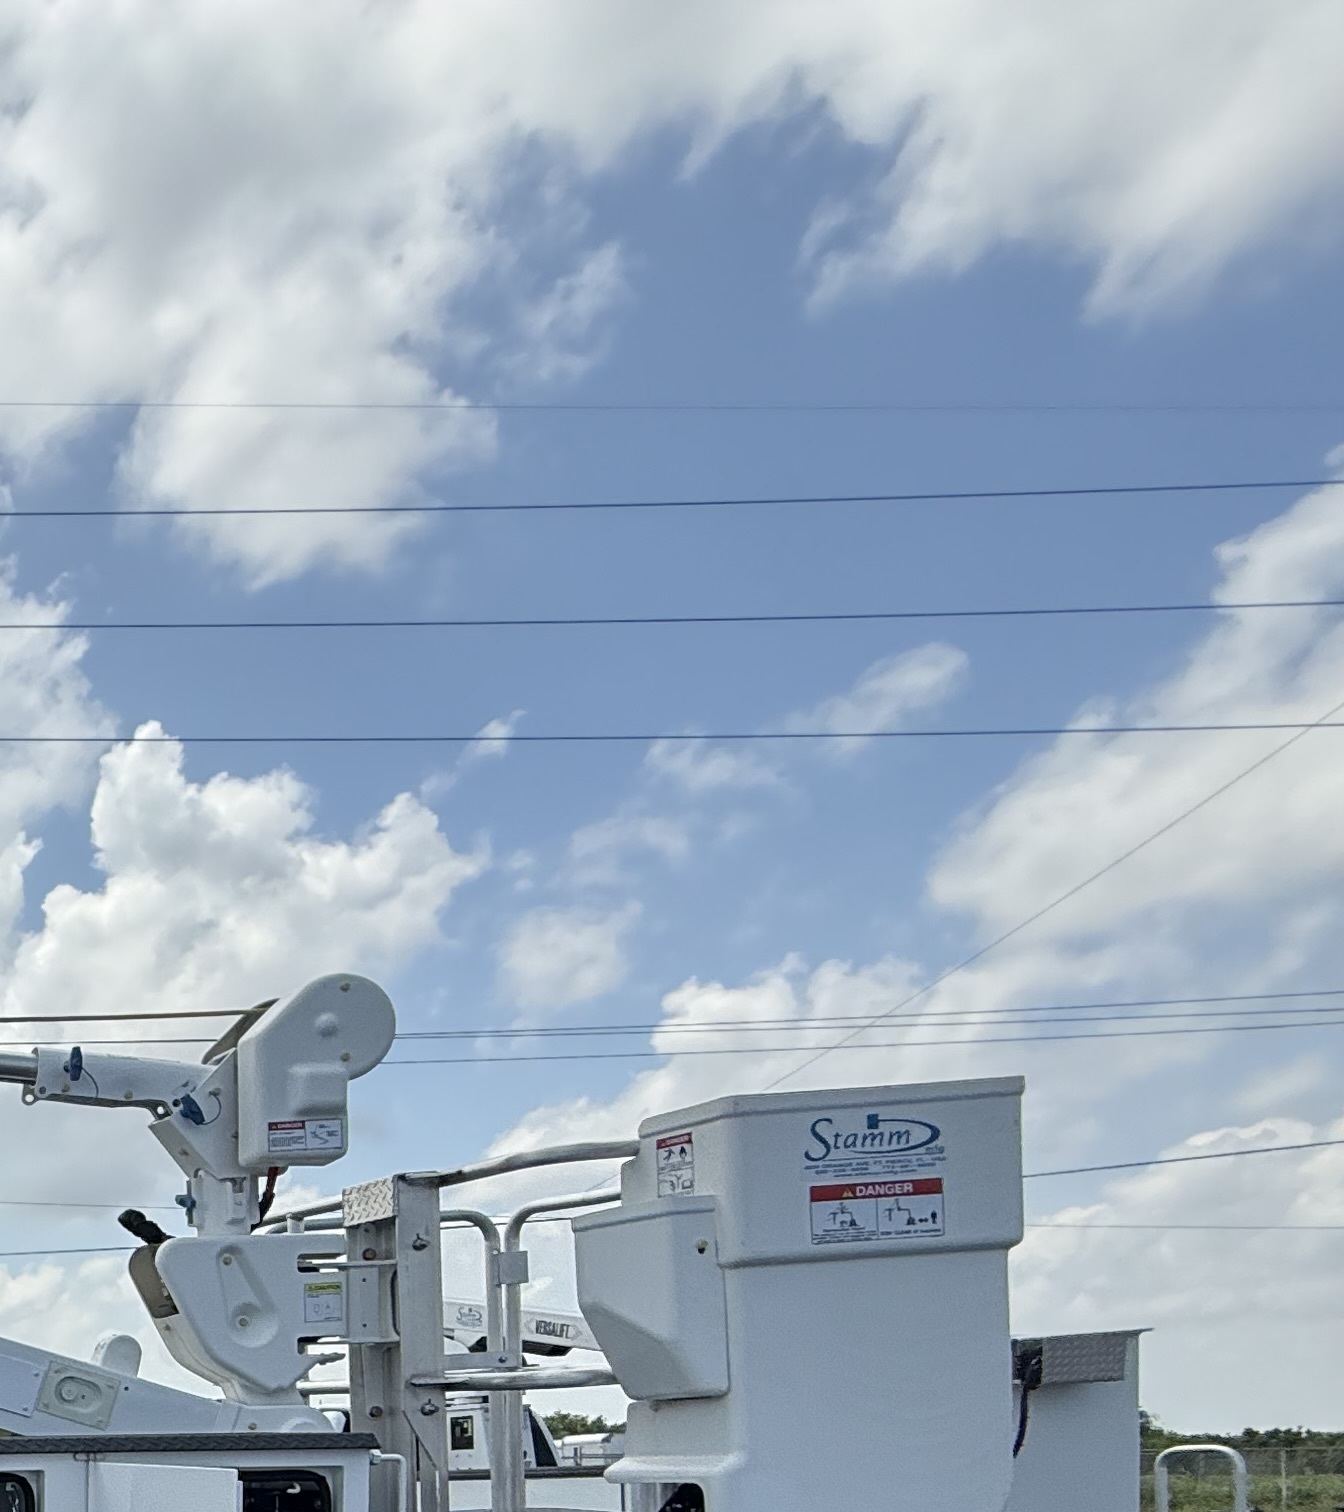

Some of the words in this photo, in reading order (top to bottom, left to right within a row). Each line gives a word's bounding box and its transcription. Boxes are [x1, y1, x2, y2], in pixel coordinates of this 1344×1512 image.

[804, 1117, 912, 1162] Stamm
[855, 1182, 914, 1197] DANGER
[535, 1319, 573, 1340] VERSALIFT
